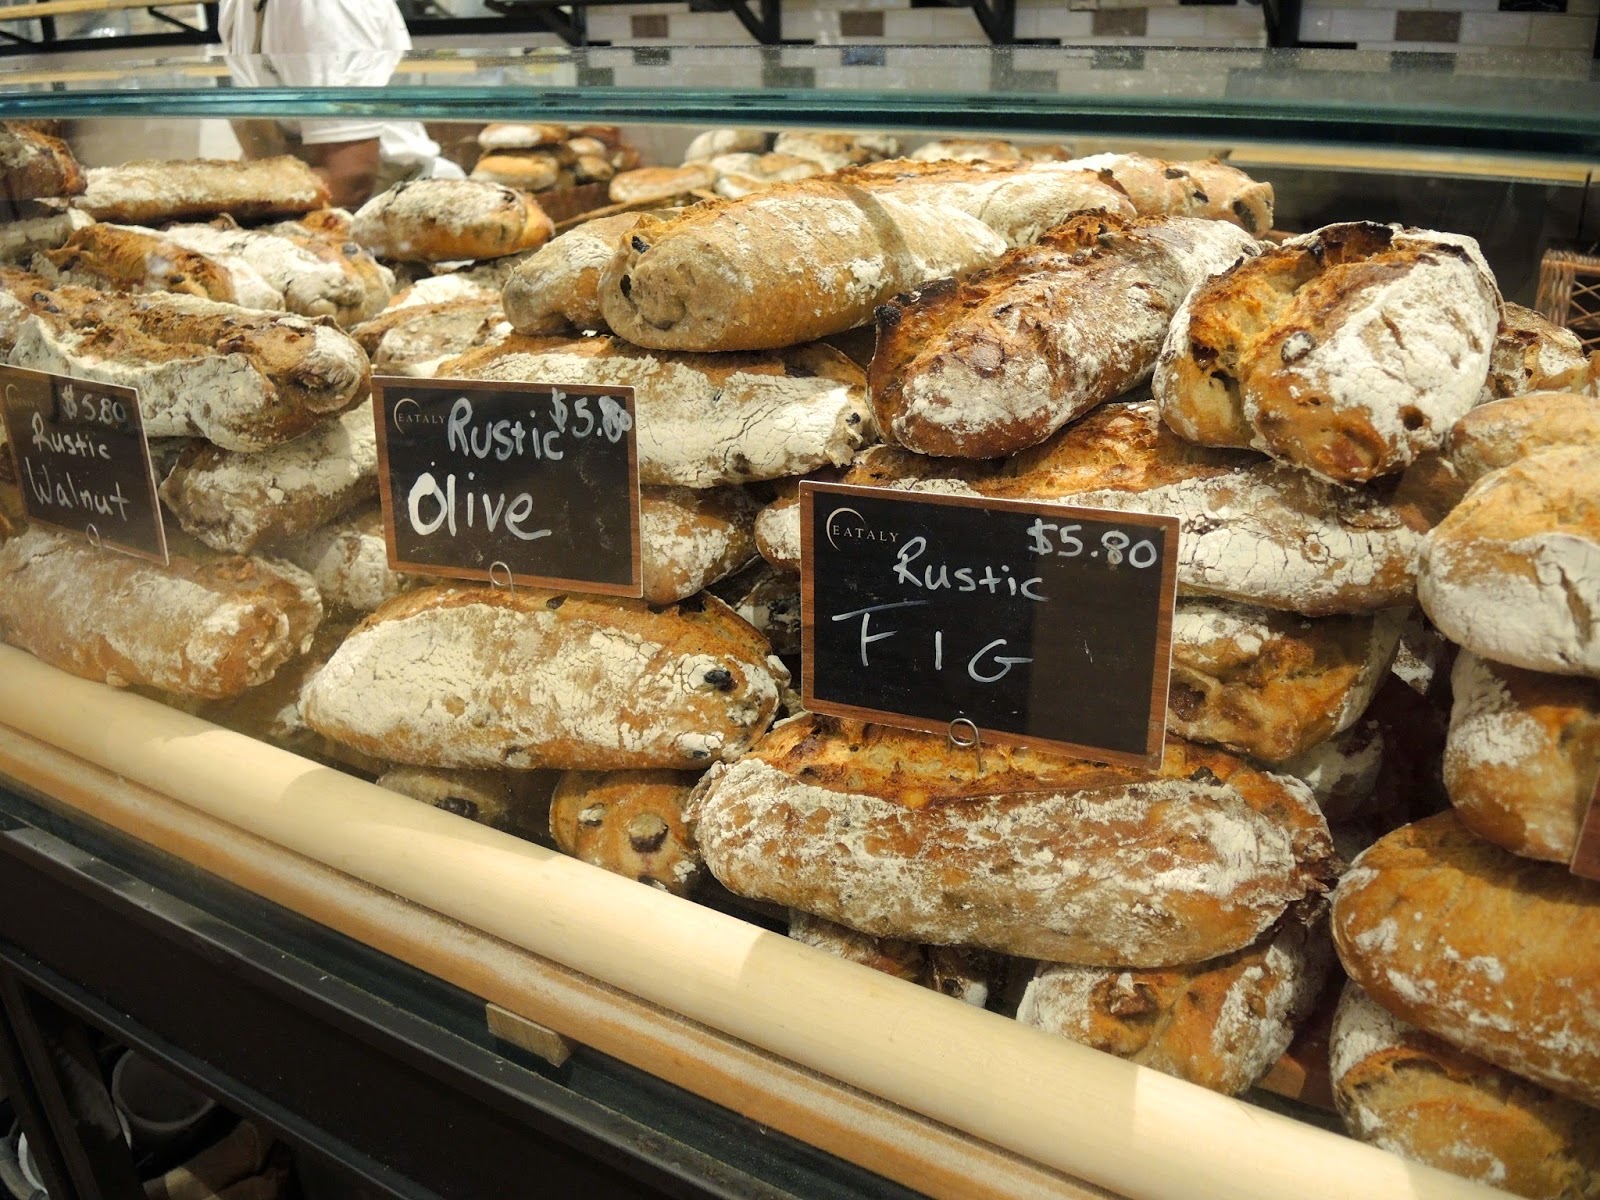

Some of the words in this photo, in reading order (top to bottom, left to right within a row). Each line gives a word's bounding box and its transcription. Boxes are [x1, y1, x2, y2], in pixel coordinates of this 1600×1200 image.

[31, 411, 112, 461] Rustic
[397, 412, 446, 425] EATALY
[447, 397, 564, 461] Rustic
[24, 456, 131, 522] Walnut
[407, 460, 553, 541] Olive
[832, 524, 899, 543] EATALY
[1026, 518, 1157, 569] $5.80
[893, 536, 1052, 601] Rustic
[831, 600, 1034, 683] FIG
